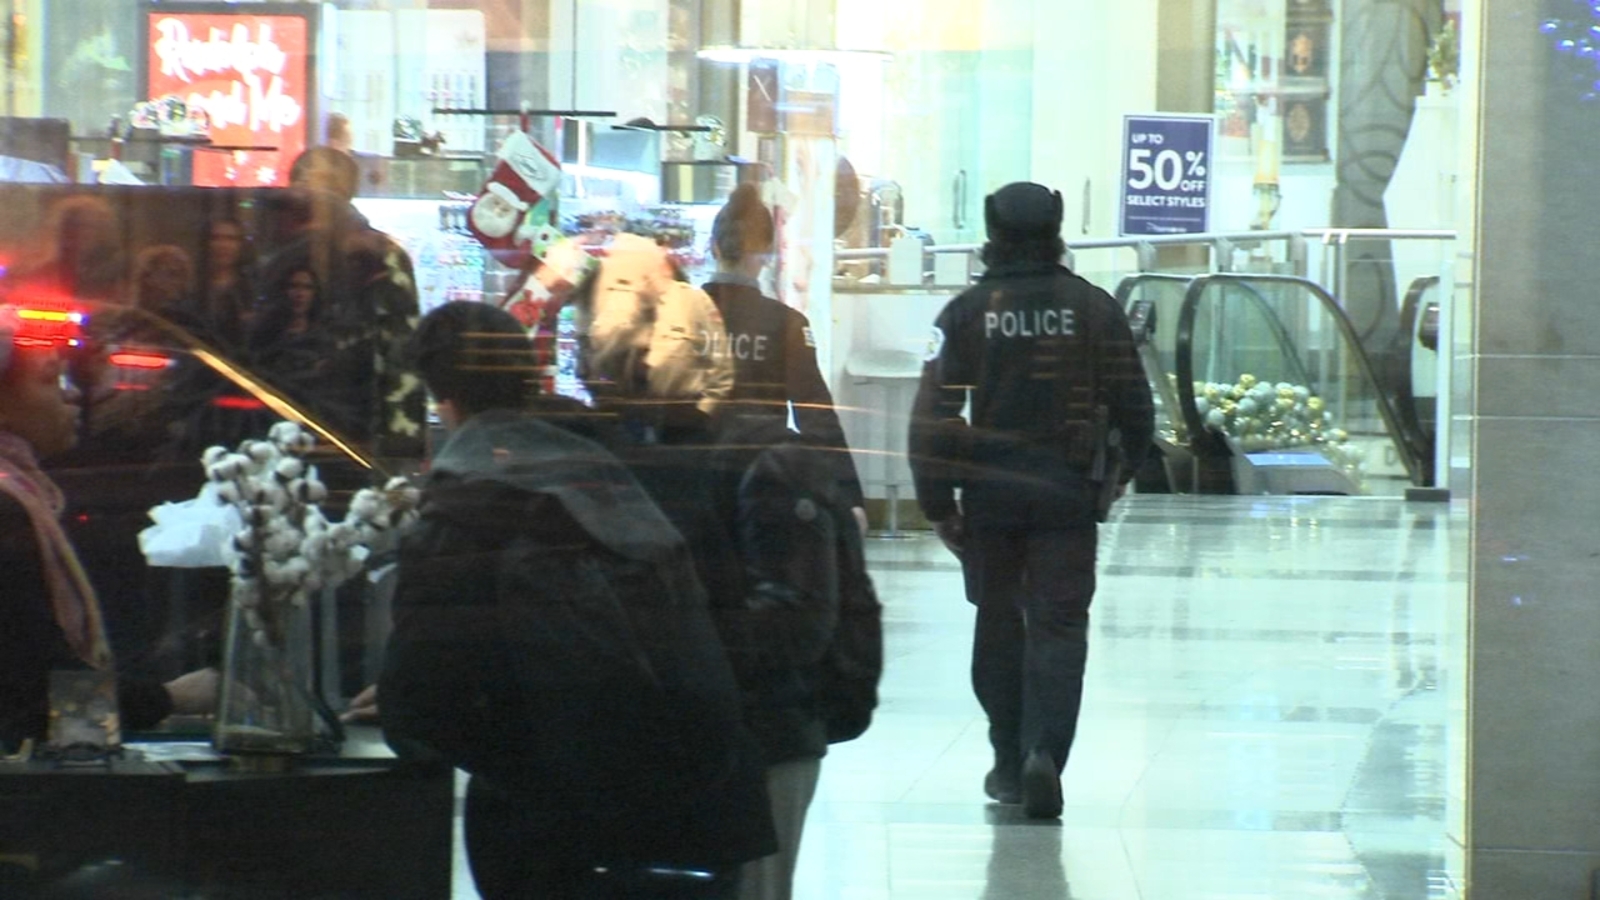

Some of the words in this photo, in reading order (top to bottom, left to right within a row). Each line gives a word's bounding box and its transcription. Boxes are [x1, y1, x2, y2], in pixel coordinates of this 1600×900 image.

[1131, 133, 1147, 144] UP
[1148, 133, 1164, 145] TO
[1180, 179, 1205, 192] OFF
[1127, 195, 1166, 207] SELECT
[1167, 196, 1205, 208] STYLES
[984, 308, 1075, 340] POLICE
[691, 329, 768, 361] OLICE
